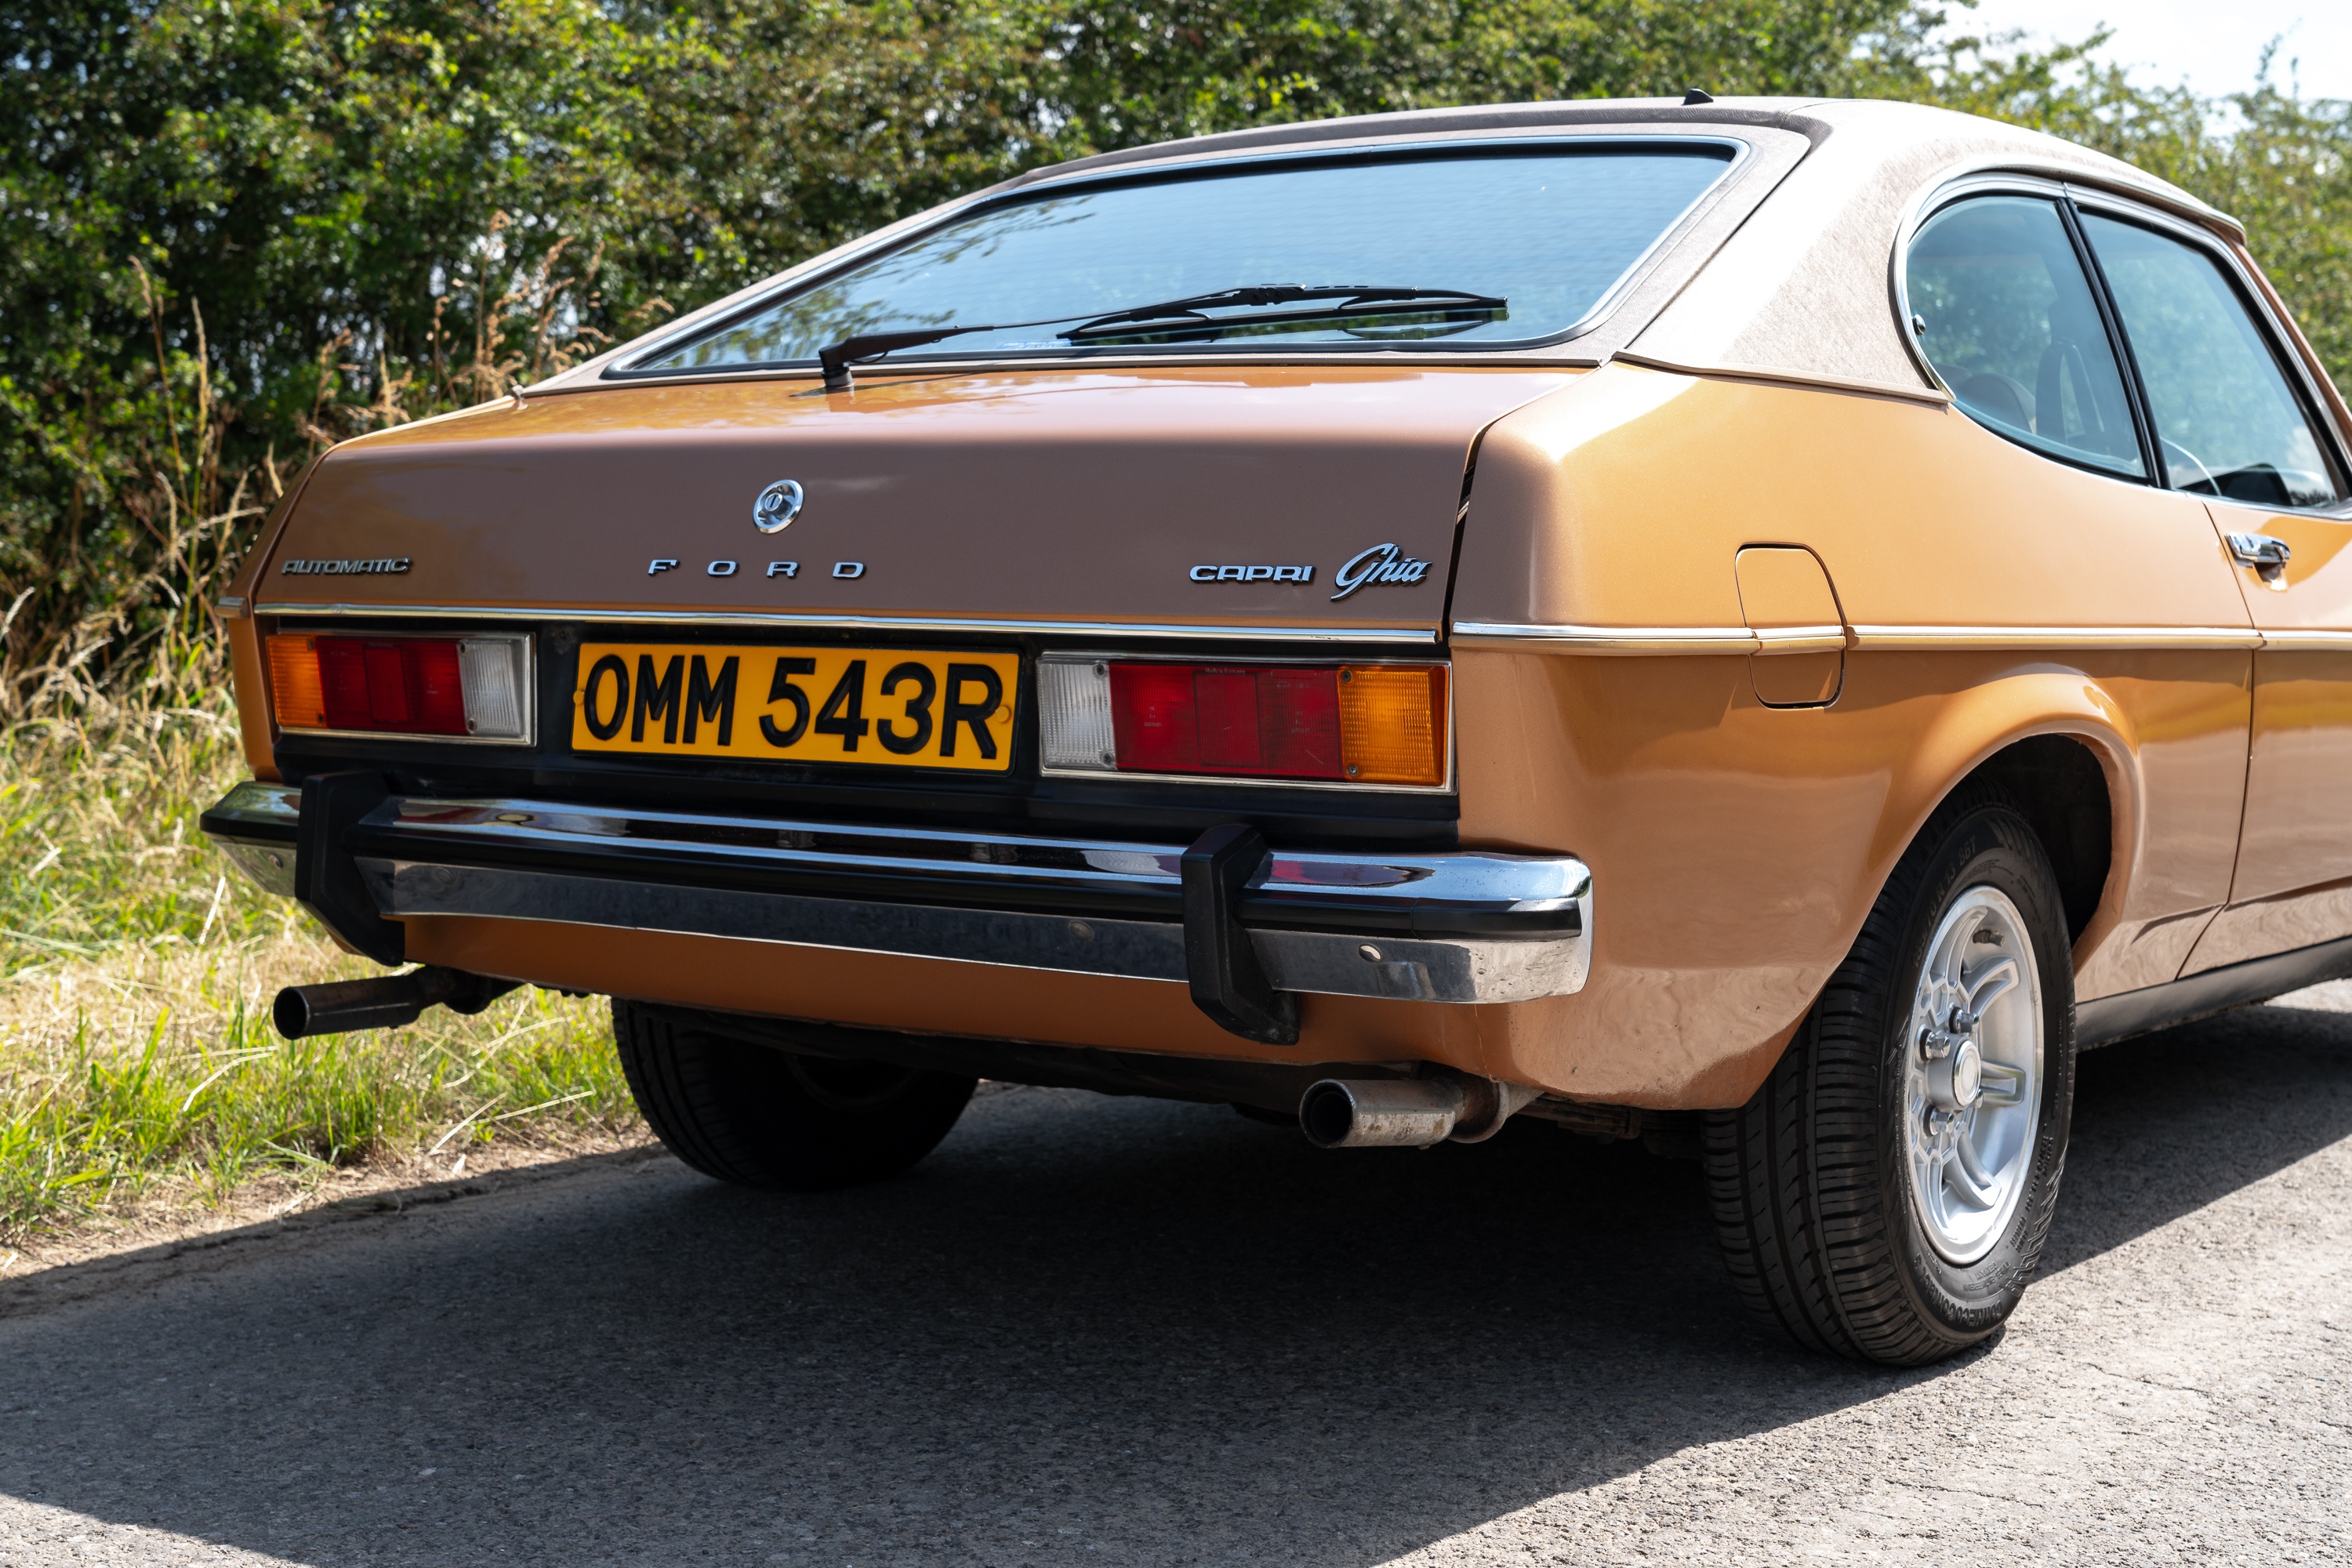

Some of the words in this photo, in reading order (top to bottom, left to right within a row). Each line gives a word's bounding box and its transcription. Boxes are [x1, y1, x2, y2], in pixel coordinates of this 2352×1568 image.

[281, 557, 412, 576] AUTOMATIC
[648, 559, 866, 579] FORD
[1189, 565, 1316, 584] CAPRI
[1330, 542, 1433, 601] Ghia
[583, 654, 740, 746] OMM
[759, 657, 1004, 760] 543R
[1944, 862, 1956, 886] 13
[1958, 834, 1976, 866] 86T
